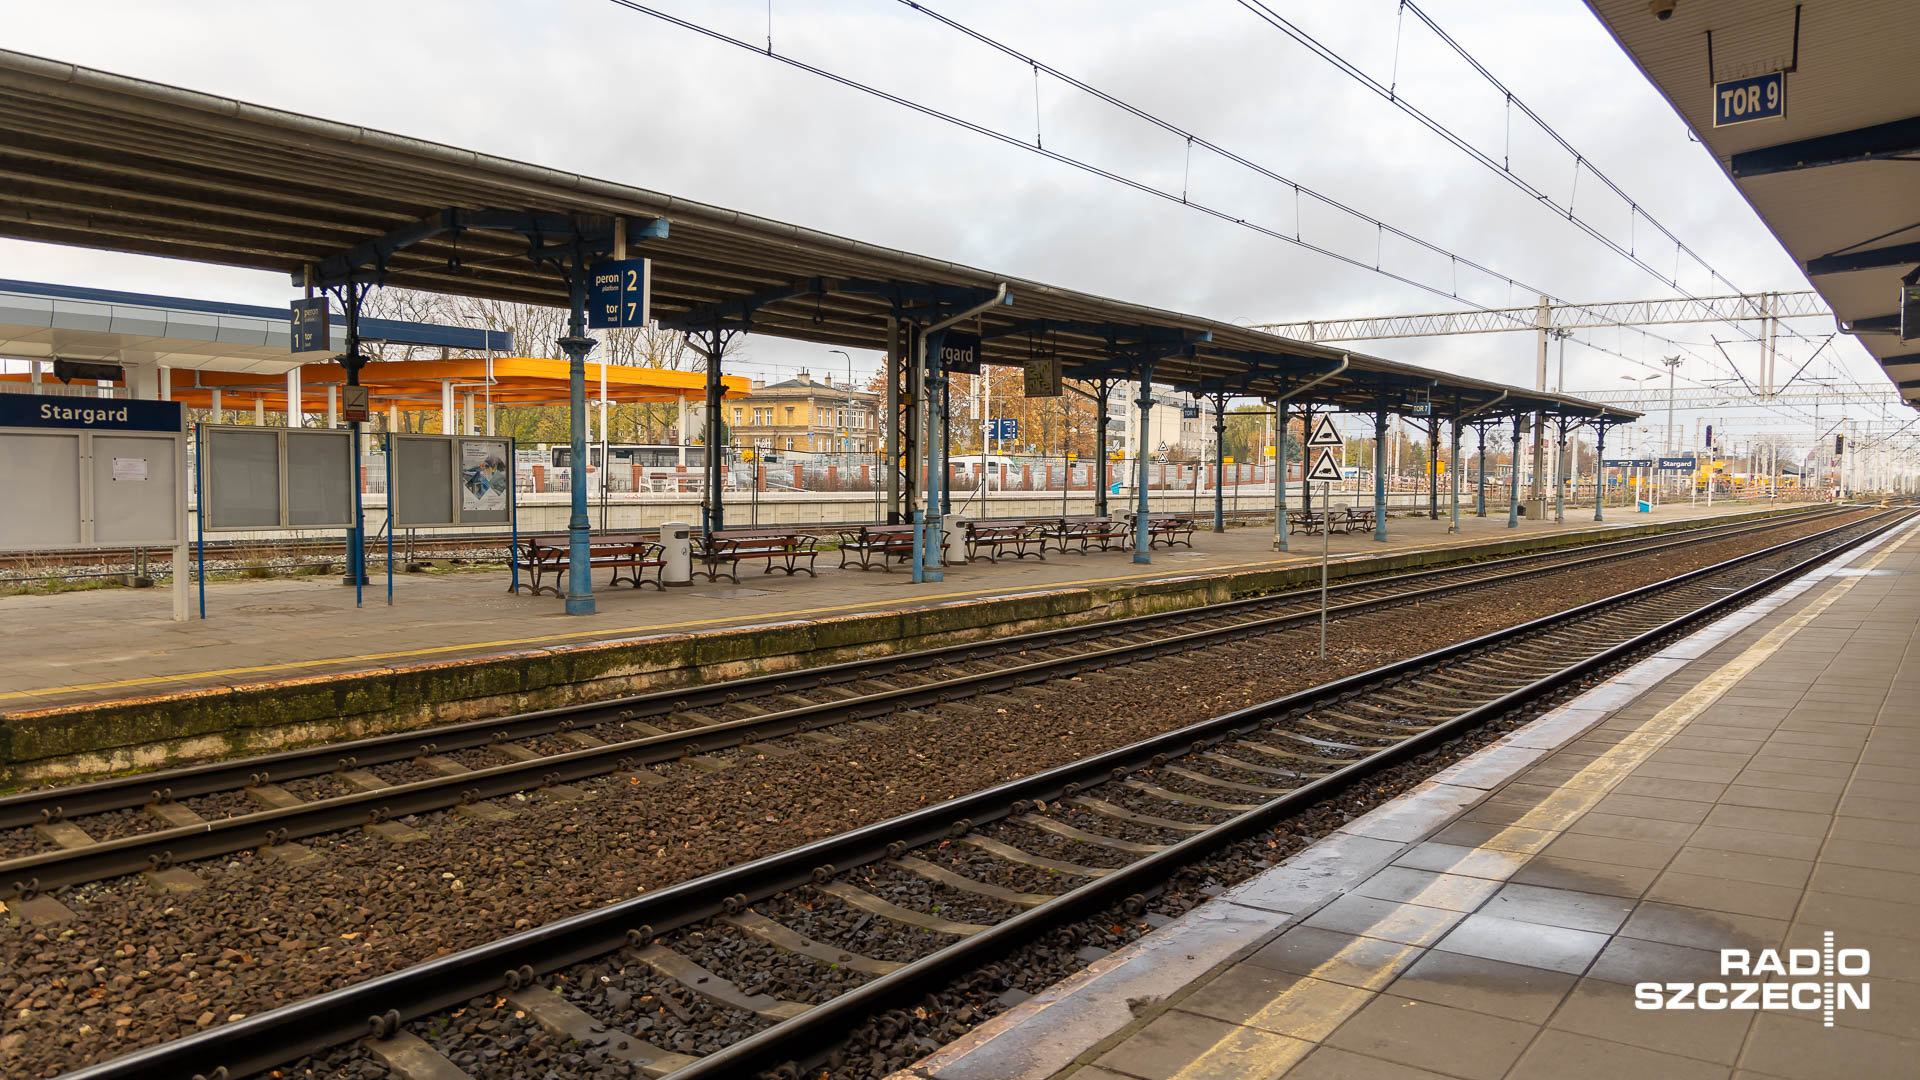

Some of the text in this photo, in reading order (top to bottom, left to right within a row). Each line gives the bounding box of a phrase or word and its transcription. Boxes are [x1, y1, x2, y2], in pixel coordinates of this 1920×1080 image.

[1721, 81, 1779, 118] TOR 9
[595, 269, 638, 292] peron 2
[293, 308, 300, 325] 2
[606, 302, 637, 321] tor 7
[294, 333, 299, 349] 1
[925, 346, 974, 365] rgard
[40, 403, 128, 424] Stargard
[1662, 460, 1692, 469] Stargard
